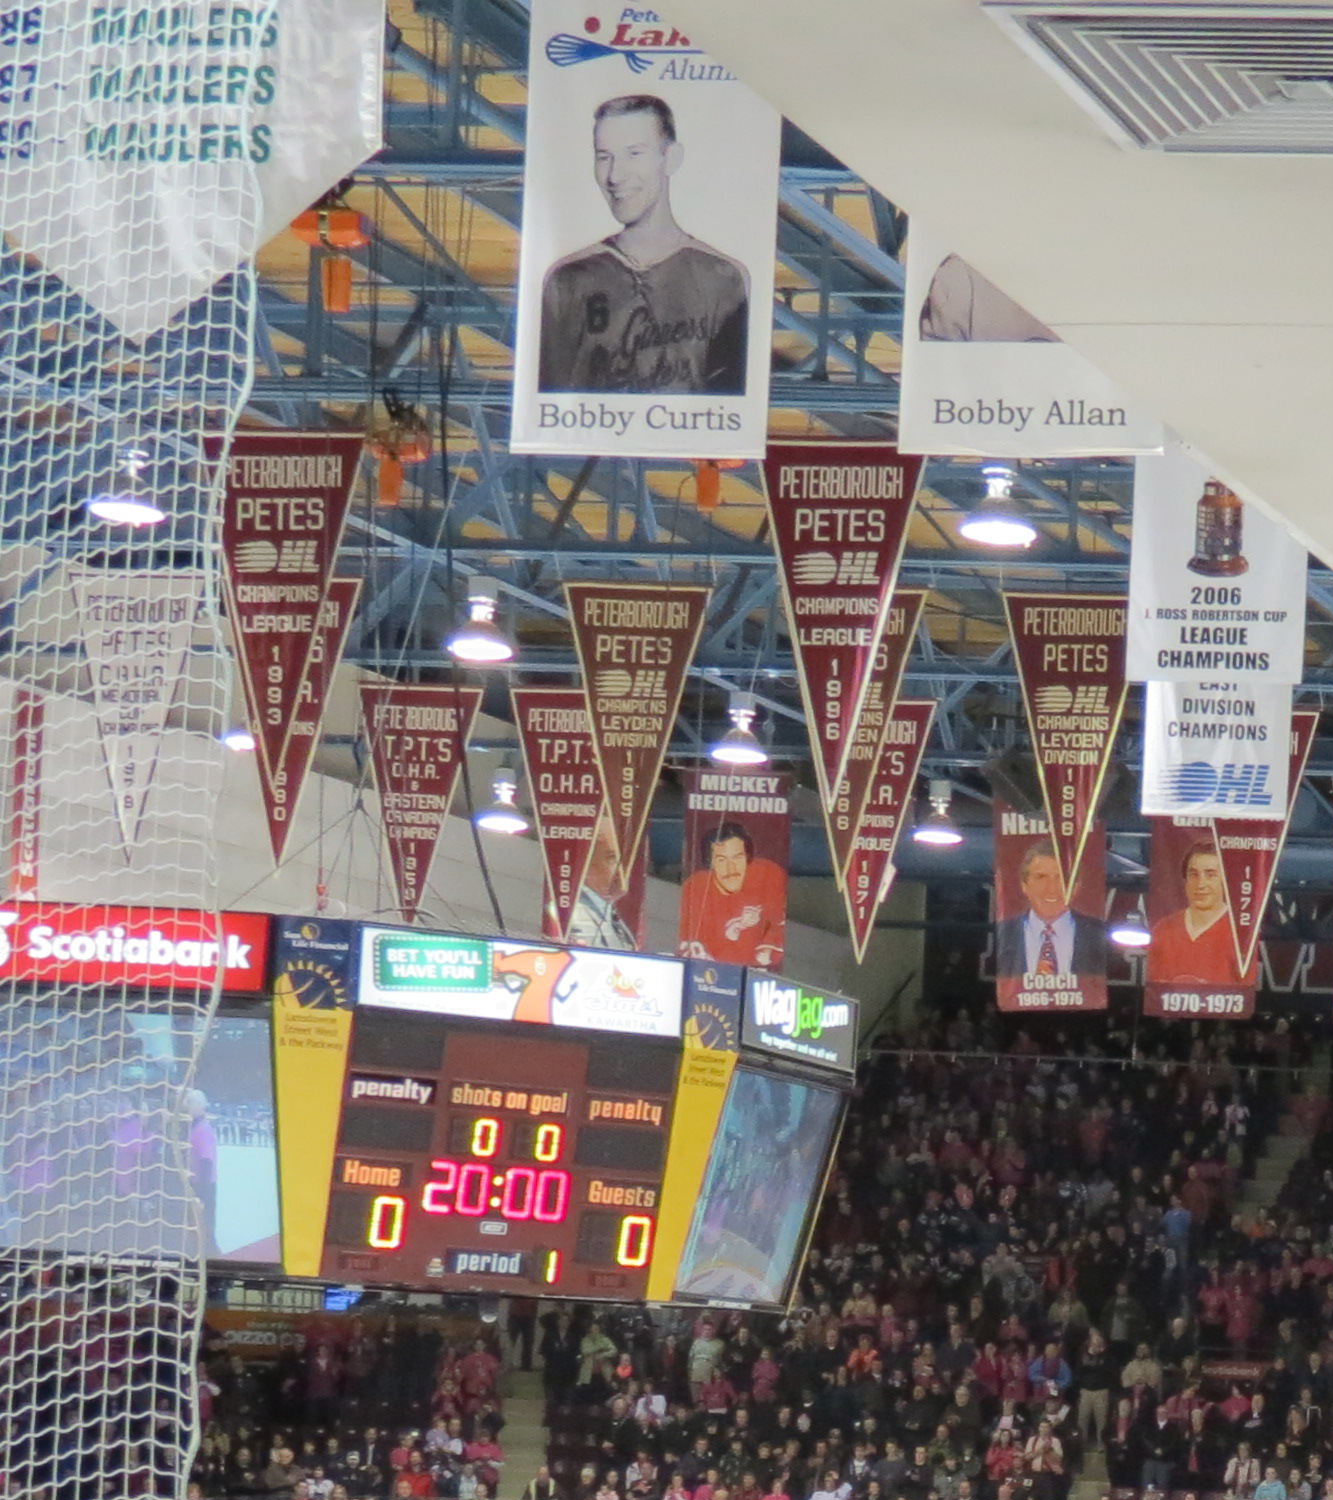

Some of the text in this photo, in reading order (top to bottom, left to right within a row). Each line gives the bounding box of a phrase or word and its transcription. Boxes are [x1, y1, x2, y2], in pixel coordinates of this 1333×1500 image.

[537, 402, 743, 437] Bobby Curtis
[933, 398, 1128, 432] Bobby Allan
[780, 465, 904, 500] PETERBOROUGH
[235, 498, 325, 531] PETES
[793, 508, 886, 543] PETES
[236, 584, 319, 603] CHAMPIONS
[1190, 586, 1243, 606] 2006
[795, 596, 880, 616] CHAMPIONS
[1156, 608, 1188, 621] ROSS
[1192, 609, 1260, 623] ROBERTSON
[1263, 610, 1288, 624] CUP
[241, 614, 313, 634] LEAGUE
[800, 627, 872, 647] LEAGUE
[1179, 625, 1249, 647] LEAGUE
[595, 634, 672, 665] PETES
[1042, 643, 1109, 673] PETES
[1156, 649, 1271, 672] CHAMPIONS
[596, 698, 667, 715] CHAMPIONS
[1182, 697, 1256, 718] DIVISION
[601, 715, 663, 732] LEYDEN
[1036, 715, 1110, 732] CHAMPIONS
[1167, 721, 1269, 742] CHAMPIONS
[603, 732, 657, 749] DIVISION
[1040, 732, 1104, 749] LEYDEN
[1043, 749, 1099, 766] DIVISION
[539, 772, 600, 795] O.H.A.
[700, 773, 780, 795] MICKEY
[540, 802, 597, 818] CHAMPIONS
[688, 793, 788, 815] REDMOND
[541, 825, 594, 841] LEAGUE
[1219, 835, 1278, 851] CHAMPIONS
[26, 924, 251, 970] Scotiabank
[386, 948, 483, 966] BET YOU'LL
[392, 963, 475, 980] HAVE FUN
[1023, 972, 1078, 990] Coach
[1016, 990, 1084, 1007] 1966-1976
[1160, 992, 1245, 1014] 1970-1973
[352, 1078, 433, 1105] penalty
[452, 1083, 568, 1116] shots on goal
[589, 1100, 662, 1126] penalty
[471, 1117, 500, 1157] 0
[534, 1123, 561, 1163] 0
[343, 1159, 402, 1188] Home
[421, 1160, 570, 1222] 20:00
[588, 1180, 656, 1207] Guests
[368, 1195, 405, 1249] 0
[617, 1215, 652, 1267] 0
[455, 1251, 521, 1275] period
